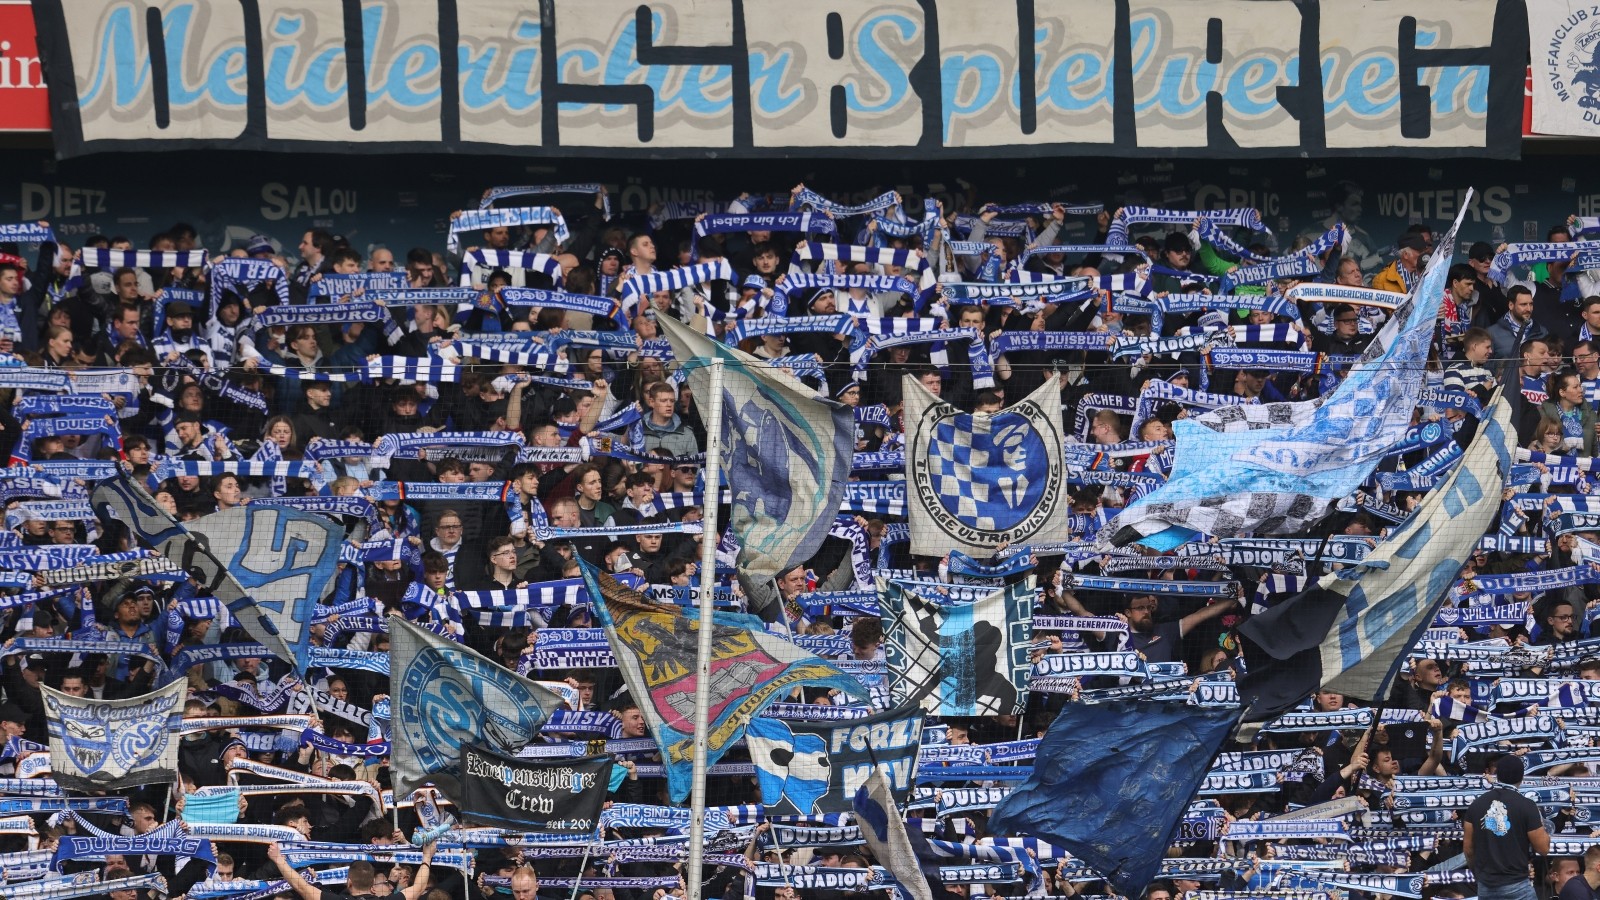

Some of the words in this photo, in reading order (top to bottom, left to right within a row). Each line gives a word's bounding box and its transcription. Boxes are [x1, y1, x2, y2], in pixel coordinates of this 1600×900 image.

[1547, 9, 1589, 102] MSV-FANCLUB
[846, 14, 1492, 143] Spielverein
[21, 182, 107, 220] DIETZ
[260, 182, 357, 221] SALOU
[1378, 186, 1513, 224] WOLTERS
[711, 215, 749, 227] dabei
[753, 214, 775, 226] bin
[777, 214, 800, 225] Ich
[1217, 231, 1244, 252] MSV
[1517, 250, 1569, 262] WALK
[1232, 266, 1275, 286] ZEBRAS
[1276, 261, 1303, 277] SIND
[171, 289, 194, 301] WIR
[318, 280, 365, 297] ZEBRAS
[366, 291, 401, 302] MSV
[405, 290, 479, 301] Duisburg
[967, 283, 1065, 299] DUISBURG
[1300, 286, 1324, 297] JAHRE
[1325, 288, 1374, 301] MEIDERICHER
[271, 304, 299, 315] You'll
[299, 305, 326, 314] never
[327, 303, 349, 313] walk
[349, 302, 374, 311] alone
[550, 291, 612, 312] Duisburg
[264, 309, 378, 327] DUISBURG
[1009, 335, 1040, 346] MSV
[1140, 335, 1205, 353] STADION
[1256, 354, 1314, 368] Duisburg
[226, 386, 269, 413] DUISBURG
[916, 458, 959, 532] TEENAGE
[957, 527, 1011, 543] ULTRA
[1013, 463, 1059, 540] DUISBURG
[652, 588, 685, 600] MSV
[825, 595, 877, 605] DUISBURG
[1053, 617, 1075, 629] ÜBER
[23, 638, 145, 652] DAUERZEBRA
[188, 646, 223, 662] MSV
[314, 648, 339, 658] SIND
[340, 649, 388, 663] ZEBRAS
[530, 649, 559, 668] FÜR
[1036, 653, 1139, 674] DUISBURG
[96, 691, 180, 725] Generation
[561, 710, 614, 726] MSV!
[831, 713, 923, 754] FORZA
[1223, 752, 1293, 773] STADION
[466, 750, 598, 793] Kneipenschläger
[504, 788, 554, 815] Crew
[620, 807, 641, 819] WIR
[643, 808, 670, 820] SIND
[545, 818, 568, 830] seit
[1262, 823, 1339, 834] DUISBURG
[193, 826, 246, 837] MEIDERICHER
[247, 827, 295, 841] SPIELVEREIN
[71, 836, 203, 856] DUISBURG
[793, 872, 868, 889] STADION
